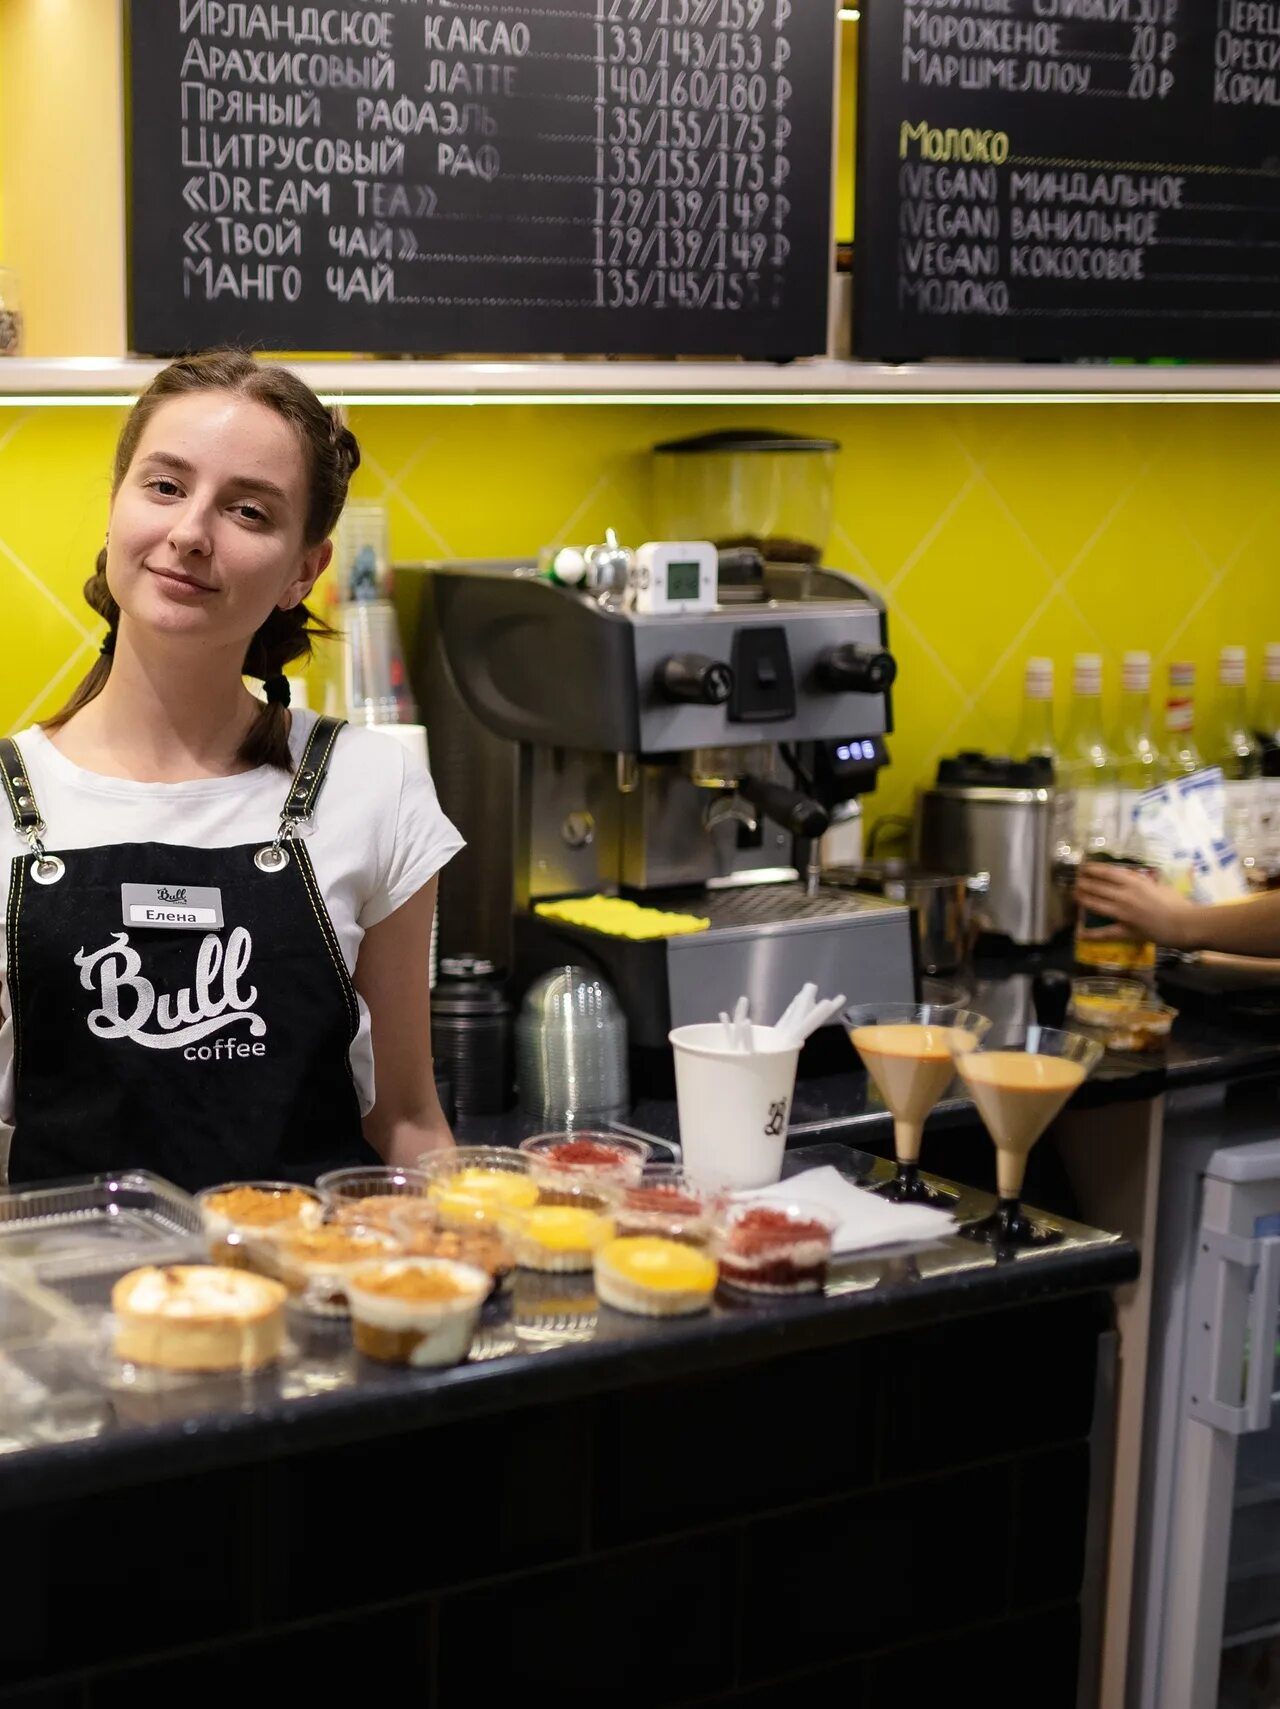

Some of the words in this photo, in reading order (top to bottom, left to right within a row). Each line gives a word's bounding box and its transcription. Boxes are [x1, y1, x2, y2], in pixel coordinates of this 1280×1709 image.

[179, 0, 395, 49] ИРЛАНДСКОЕ
[423, 15, 531, 57] КАКАО
[592, 22, 763, 72] 133/143/153
[901, 7, 1063, 57] МОРОЖЕНОЕ
[179, 37, 396, 92] АРАХИСОВЫЙ
[423, 58, 519, 96] ЛАТТЕ
[593, 64, 768, 113] 140/160/180
[901, 45, 1091, 95] МАРШМЕЛЛОУ
[179, 80, 321, 128] ПРЯНЫЙ
[356, 94, 499, 137] РАФАЭЛЬ
[592, 104, 767, 152] 135/155/175
[179, 125, 406, 175] ЦИТРУСОВЫЙ
[437, 142, 502, 182] РАФ
[592, 146, 765, 192] 135/155/175
[898, 120, 1009, 164] МОЛОКО
[592, 186, 770, 231] 129/139/149
[1009, 171, 1187, 210] МИНДАЛЬНОЕ
[591, 226, 768, 271] 129/139/149
[1009, 207, 1160, 246] ВАНИЛЬНОЕ
[183, 256, 303, 301] МАНГО
[325, 261, 396, 304] ЧАЙ
[1010, 246, 1146, 281] КОКОСОВОЕ
[146, 909, 196, 922] Елена
[157, 887, 188, 902] Bull
[73, 926, 266, 1049] Bull
[183, 1038, 266, 1061] coffee
